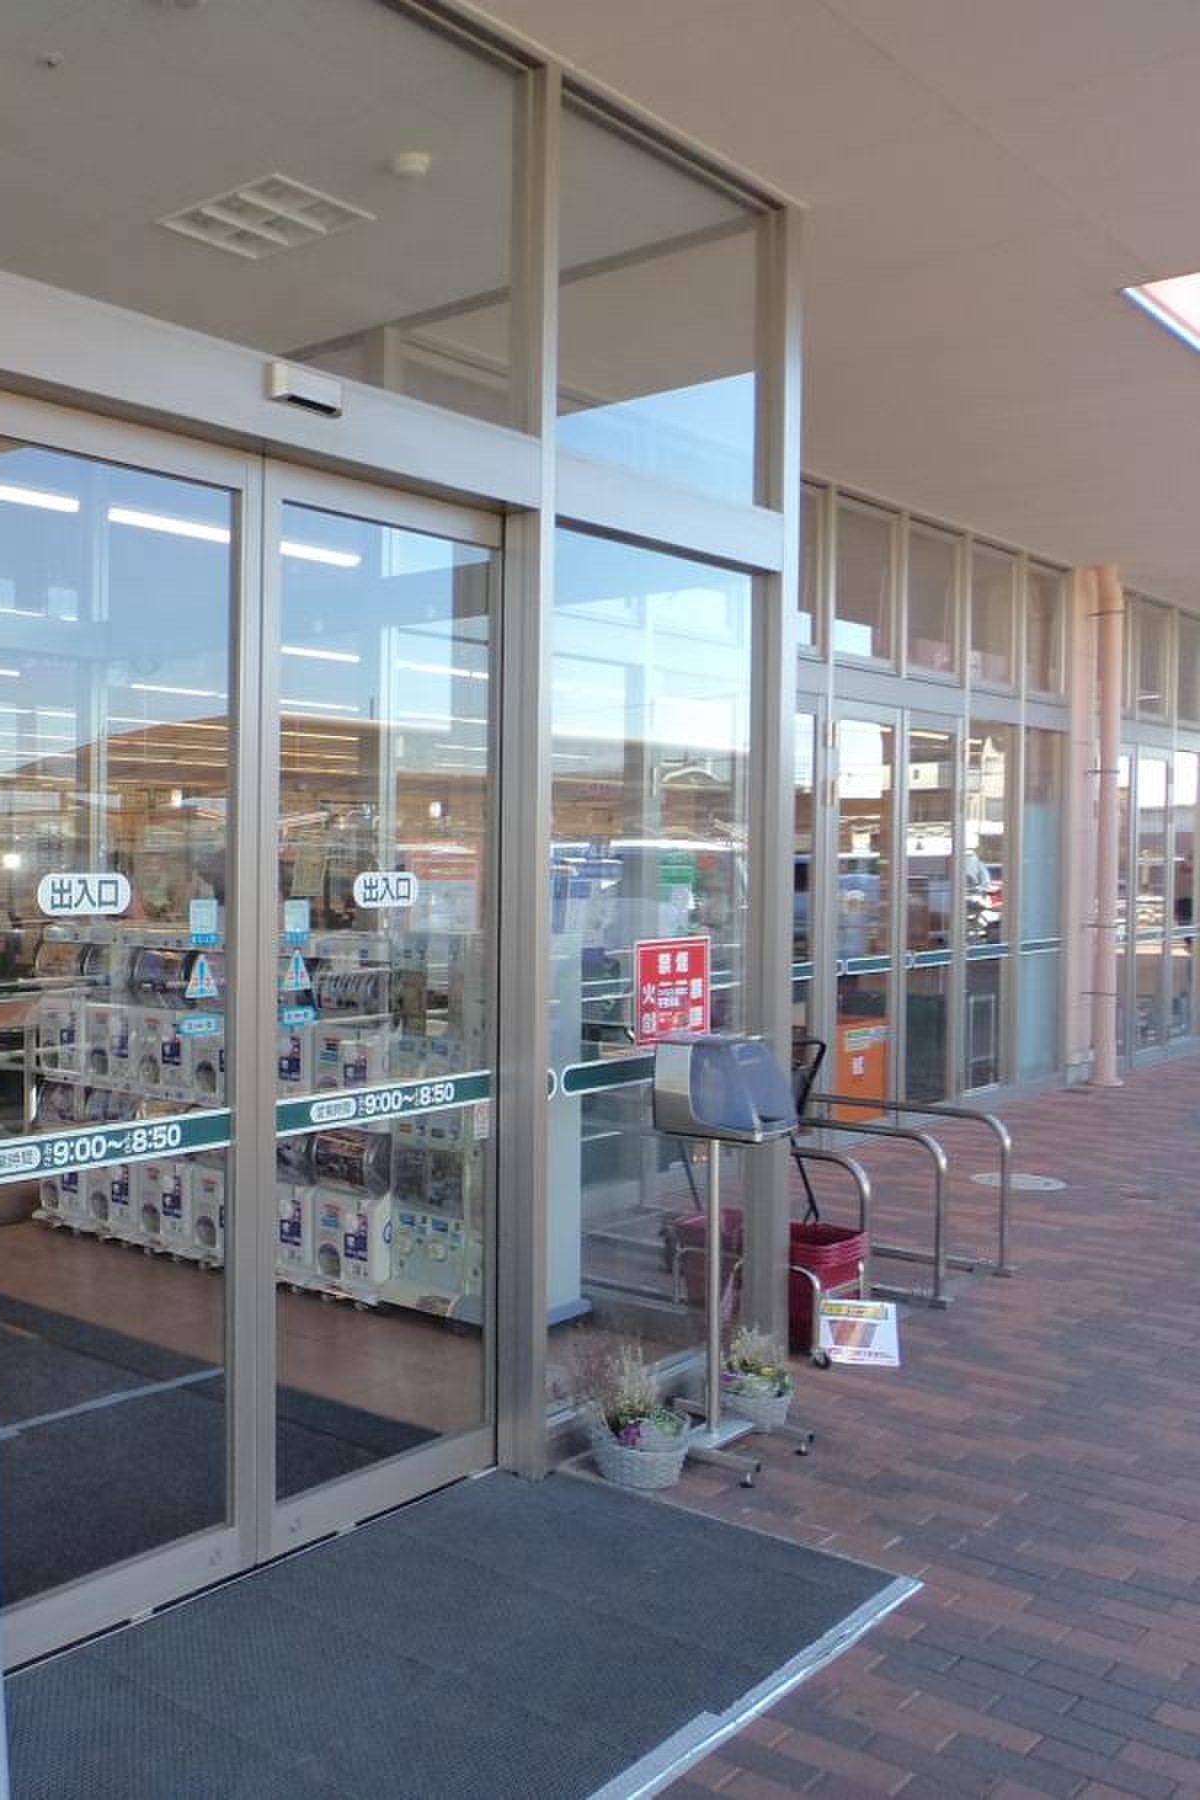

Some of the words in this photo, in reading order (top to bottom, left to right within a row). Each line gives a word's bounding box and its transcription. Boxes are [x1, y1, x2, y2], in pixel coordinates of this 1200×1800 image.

[49, 878, 120, 910] 出入口
[362, 877, 412, 903] 出入口
